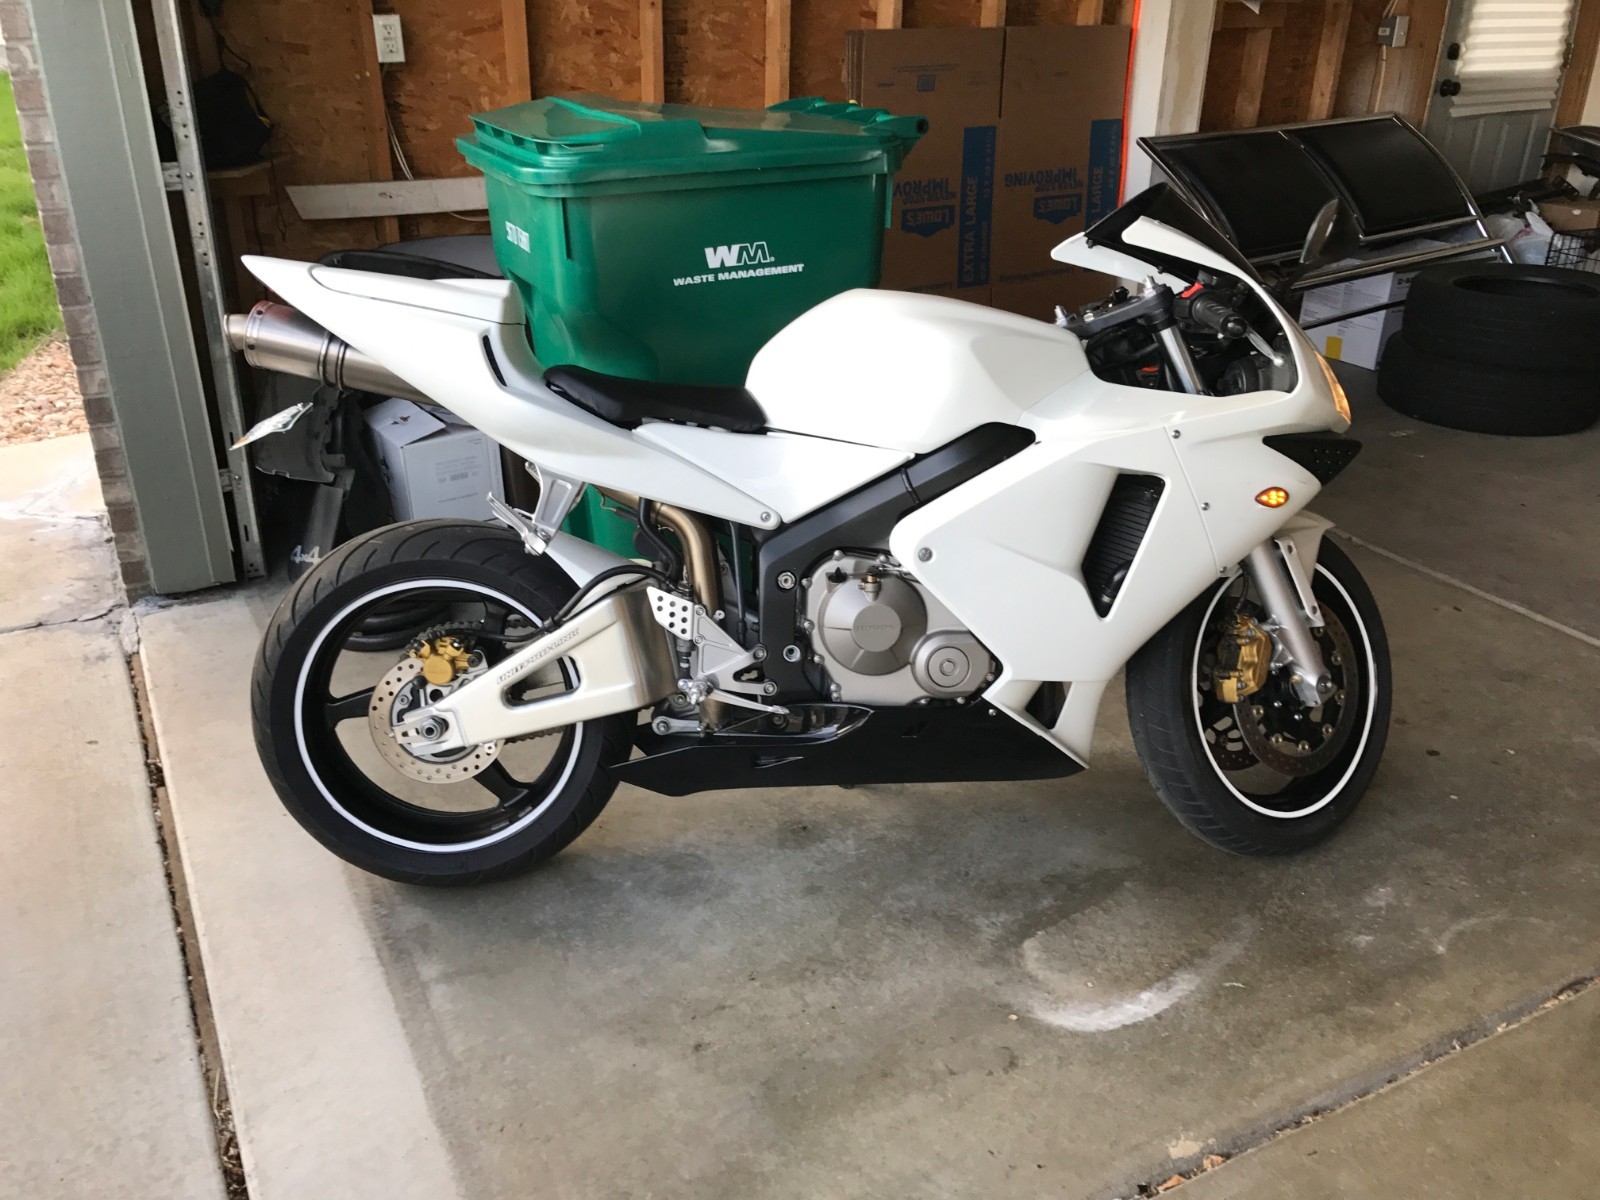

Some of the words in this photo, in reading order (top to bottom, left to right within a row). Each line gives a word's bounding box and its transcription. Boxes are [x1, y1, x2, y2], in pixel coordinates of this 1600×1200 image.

[1005, 167, 1077, 187] IMPROVING
[1091, 166, 1103, 213] LARGE
[965, 175, 978, 225] LARGE
[906, 208, 950, 228] LOWE'S
[963, 231, 975, 283] EXTRA
[673, 274, 716, 287] WASTE
[718, 263, 805, 281] MANAGEMENT
